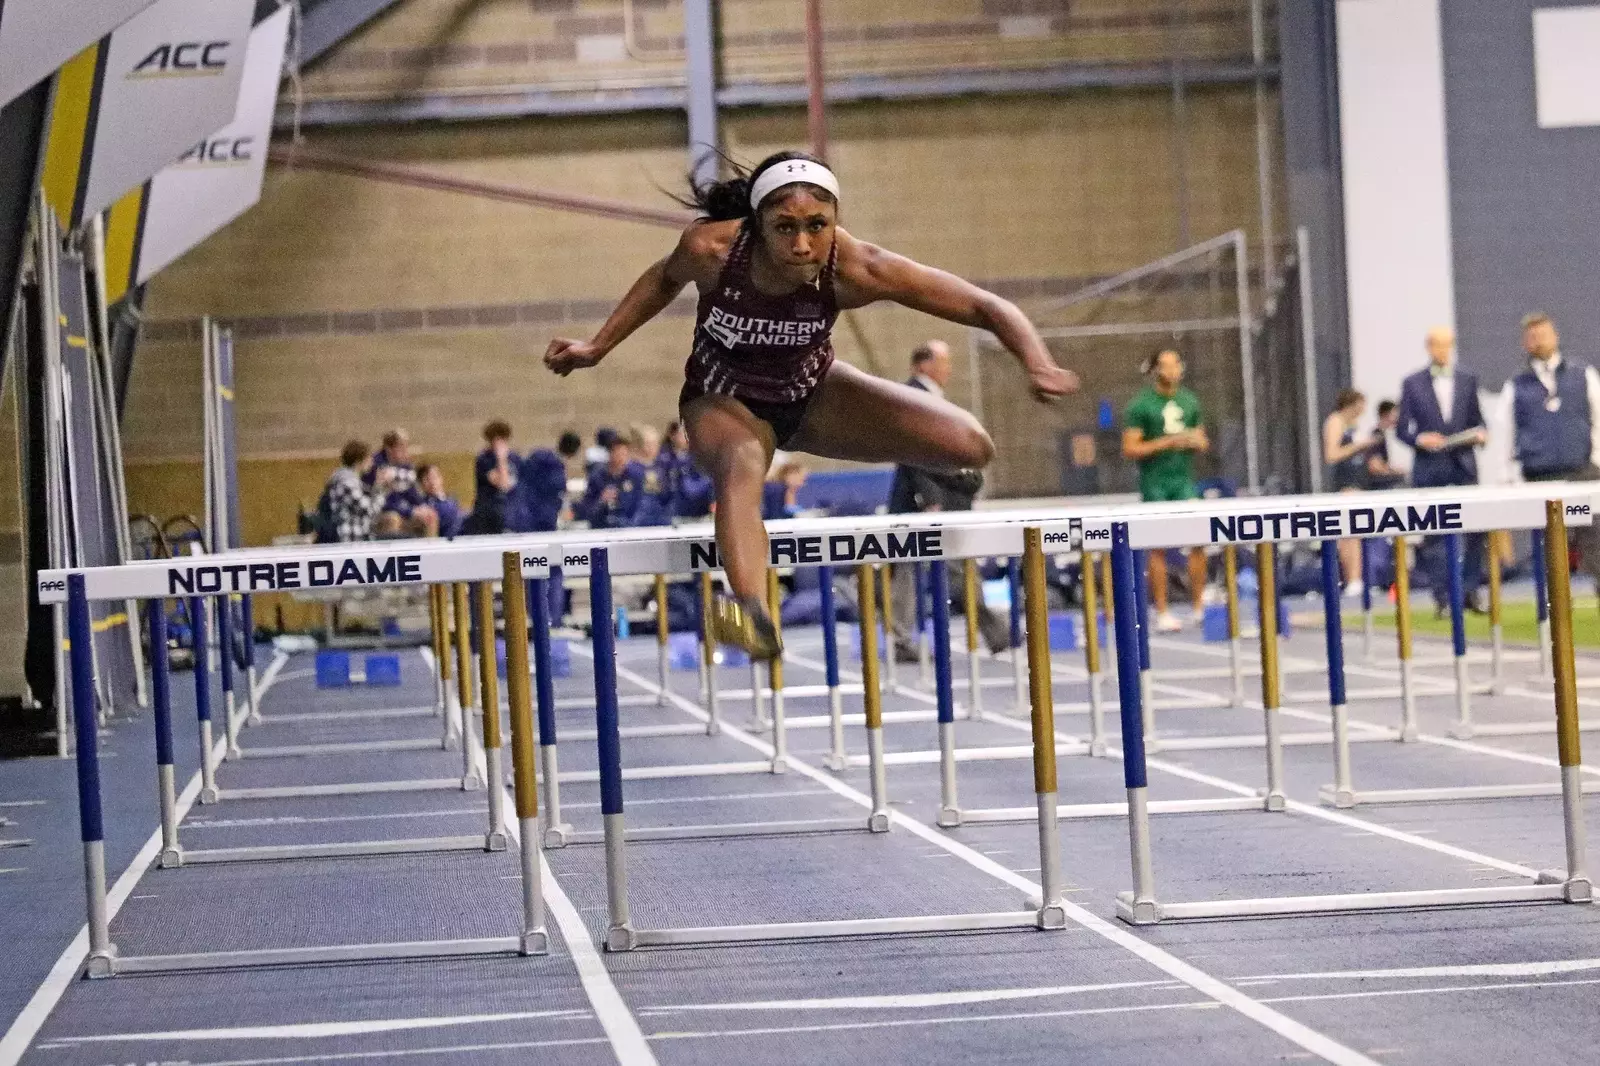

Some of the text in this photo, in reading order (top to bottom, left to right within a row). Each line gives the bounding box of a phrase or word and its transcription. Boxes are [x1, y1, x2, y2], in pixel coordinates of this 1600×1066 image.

[134, 41, 230, 71] ACC
[179, 136, 253, 162] ACC
[712, 306, 826, 334] SOUTHERN
[1210, 503, 1462, 543] NOTRE DAME
[690, 530, 943, 569] NRE DAME
[168, 555, 422, 594] NOTRE DAME
